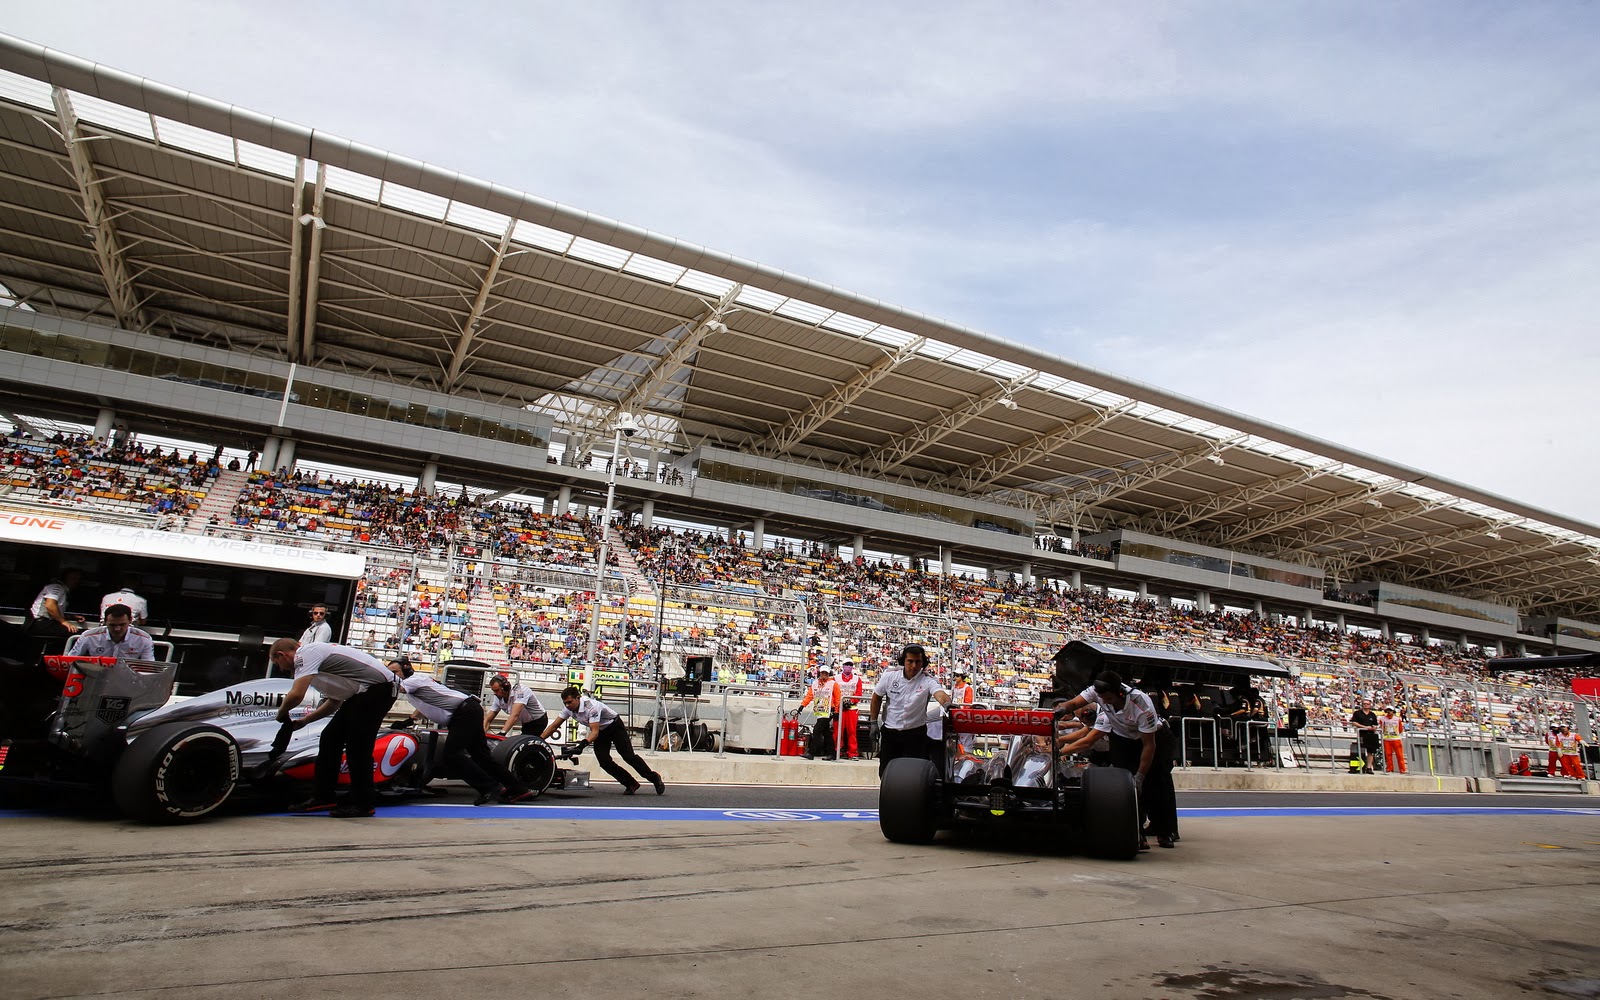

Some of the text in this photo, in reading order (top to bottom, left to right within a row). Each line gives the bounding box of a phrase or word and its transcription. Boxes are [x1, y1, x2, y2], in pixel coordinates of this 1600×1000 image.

[208, 539, 329, 562] MERCEDES
[63, 673, 85, 698] 5
[105, 698, 125, 709] TAG
[226, 690, 274, 706] Mobil
[100, 710, 125, 722] HEUER
[527, 739, 552, 754] ZERO
[155, 752, 174, 802] ZERO
